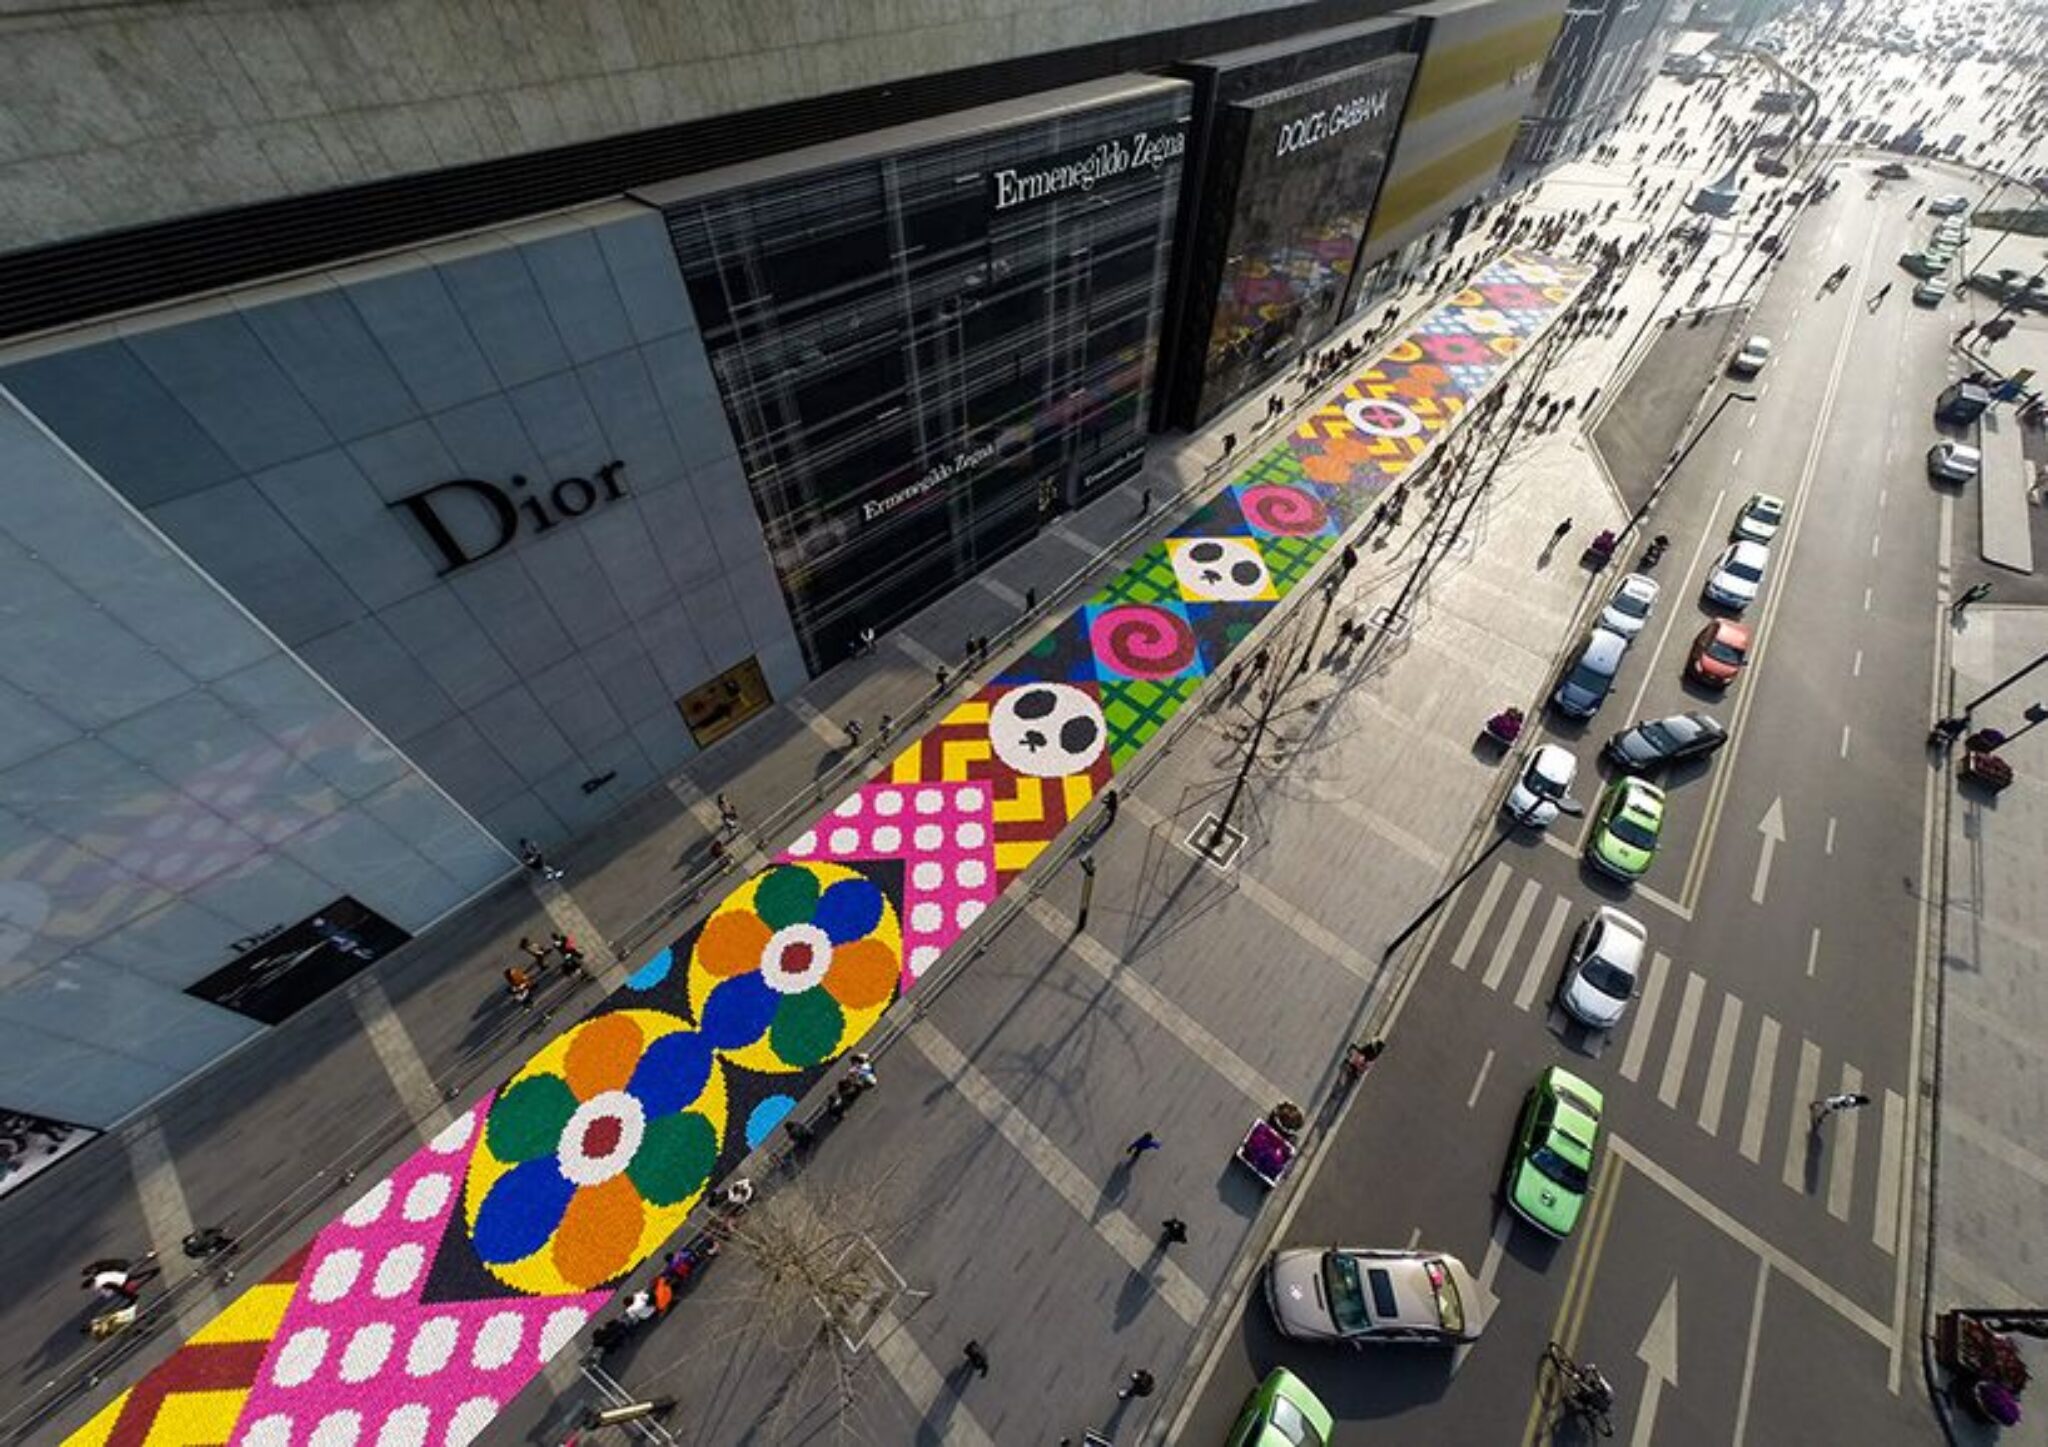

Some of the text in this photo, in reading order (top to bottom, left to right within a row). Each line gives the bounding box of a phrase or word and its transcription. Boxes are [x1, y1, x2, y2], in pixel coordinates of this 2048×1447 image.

[994, 132, 1185, 210] Ermenegildo Zegna
[385, 459, 628, 578] Dior
